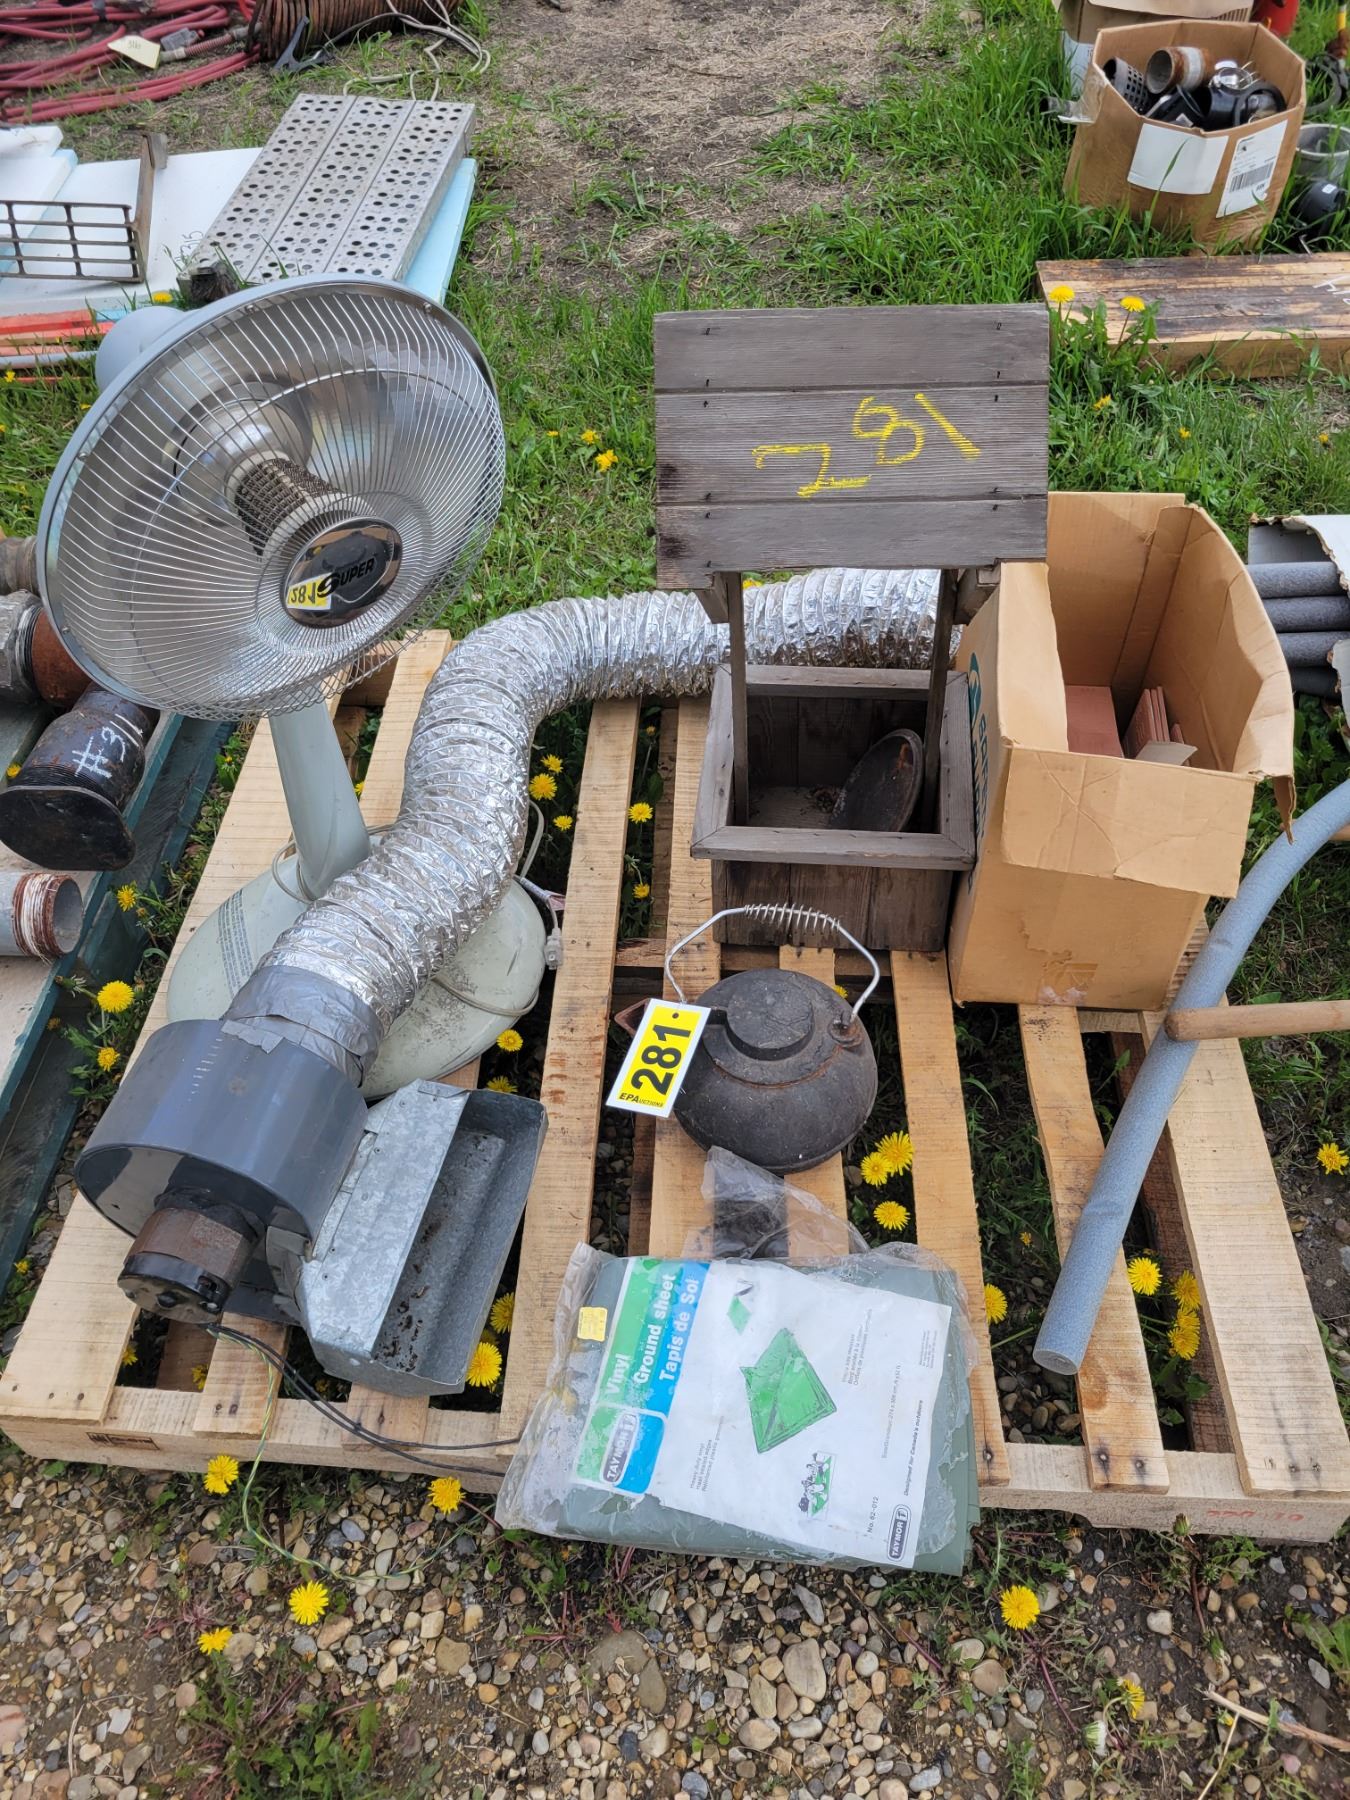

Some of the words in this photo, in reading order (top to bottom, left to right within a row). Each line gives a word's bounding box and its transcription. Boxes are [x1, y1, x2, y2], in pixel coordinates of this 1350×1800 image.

[751, 392, 982, 498] 281
[316, 557, 376, 598] SUPER
[630, 1024, 692, 1096] 281
[679, 1278, 700, 1306] Sol
[632, 1324, 662, 1385] Ground
[653, 1273, 677, 1320] sheet
[673, 1311, 690, 1332] de
[605, 1353, 632, 1396] Vinyl
[658, 1335, 684, 1383] Tapis
[891, 1521, 904, 1557] TAYMOR
